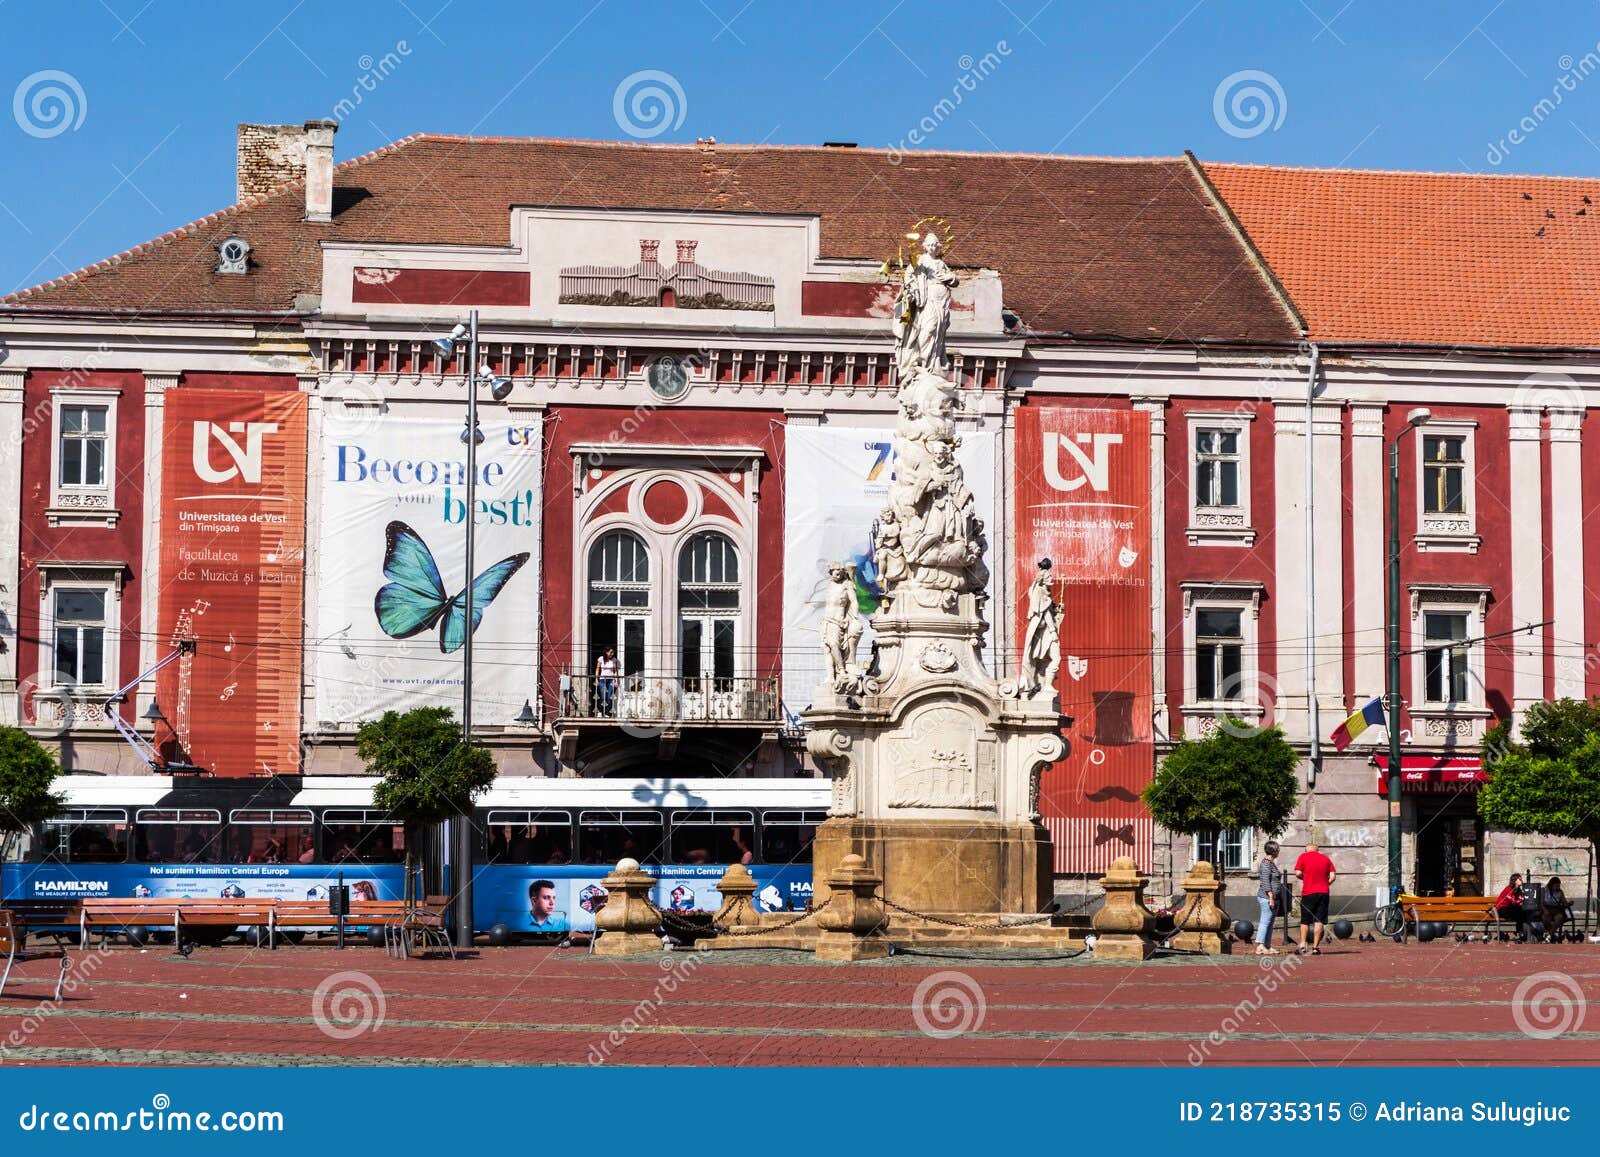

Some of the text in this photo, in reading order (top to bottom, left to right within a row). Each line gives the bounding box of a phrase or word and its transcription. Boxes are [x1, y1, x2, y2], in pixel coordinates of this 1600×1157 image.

[333, 445, 504, 486] Become
[444, 487, 533, 527] best!
[179, 511, 287, 524] Universitatea de Vest
[179, 522, 240, 533] din Timișoara
[1032, 518, 1135, 530] Universitatea de Vest
[179, 547, 238, 561] Facultatea
[178, 568, 195, 581] de
[165, 867, 195, 875] suntem
[195, 866, 230, 875] Hamilton
[231, 867, 260, 875] Central
[261, 867, 290, 877] Europe
[661, 867, 696, 876] Hamilton
[696, 867, 724, 876] Central
[34, 880, 109, 891] HAMILTON
